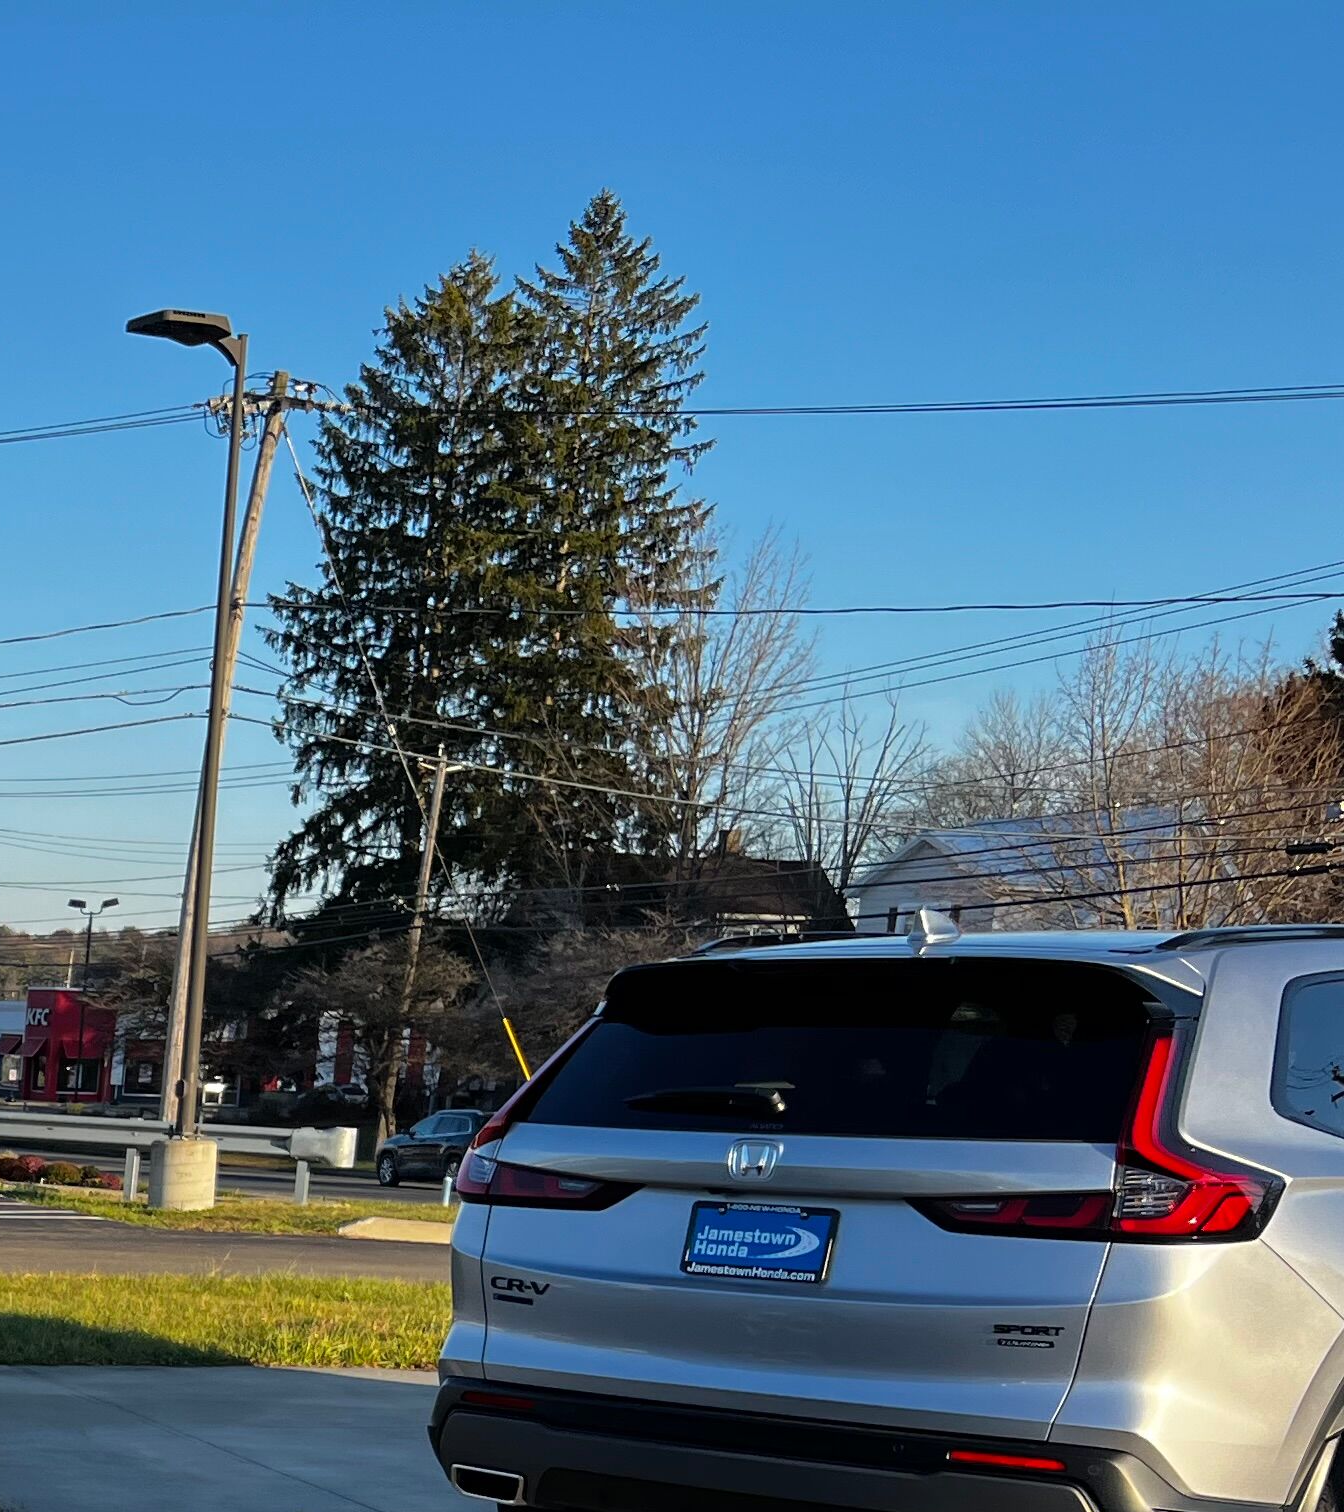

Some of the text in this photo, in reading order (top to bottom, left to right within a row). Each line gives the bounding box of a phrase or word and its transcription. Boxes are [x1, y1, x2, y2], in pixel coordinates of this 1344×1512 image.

[26, 1008, 50, 1026] KFC
[726, 1203, 801, 1214] 1-800-NEW-HONDA
[697, 1225, 795, 1245] Jamestown
[694, 1240, 748, 1258] Honda
[687, 1262, 815, 1281] JamestownHonda.com
[491, 1276, 551, 1295] CR-V
[994, 1325, 1065, 1336] SPORT
